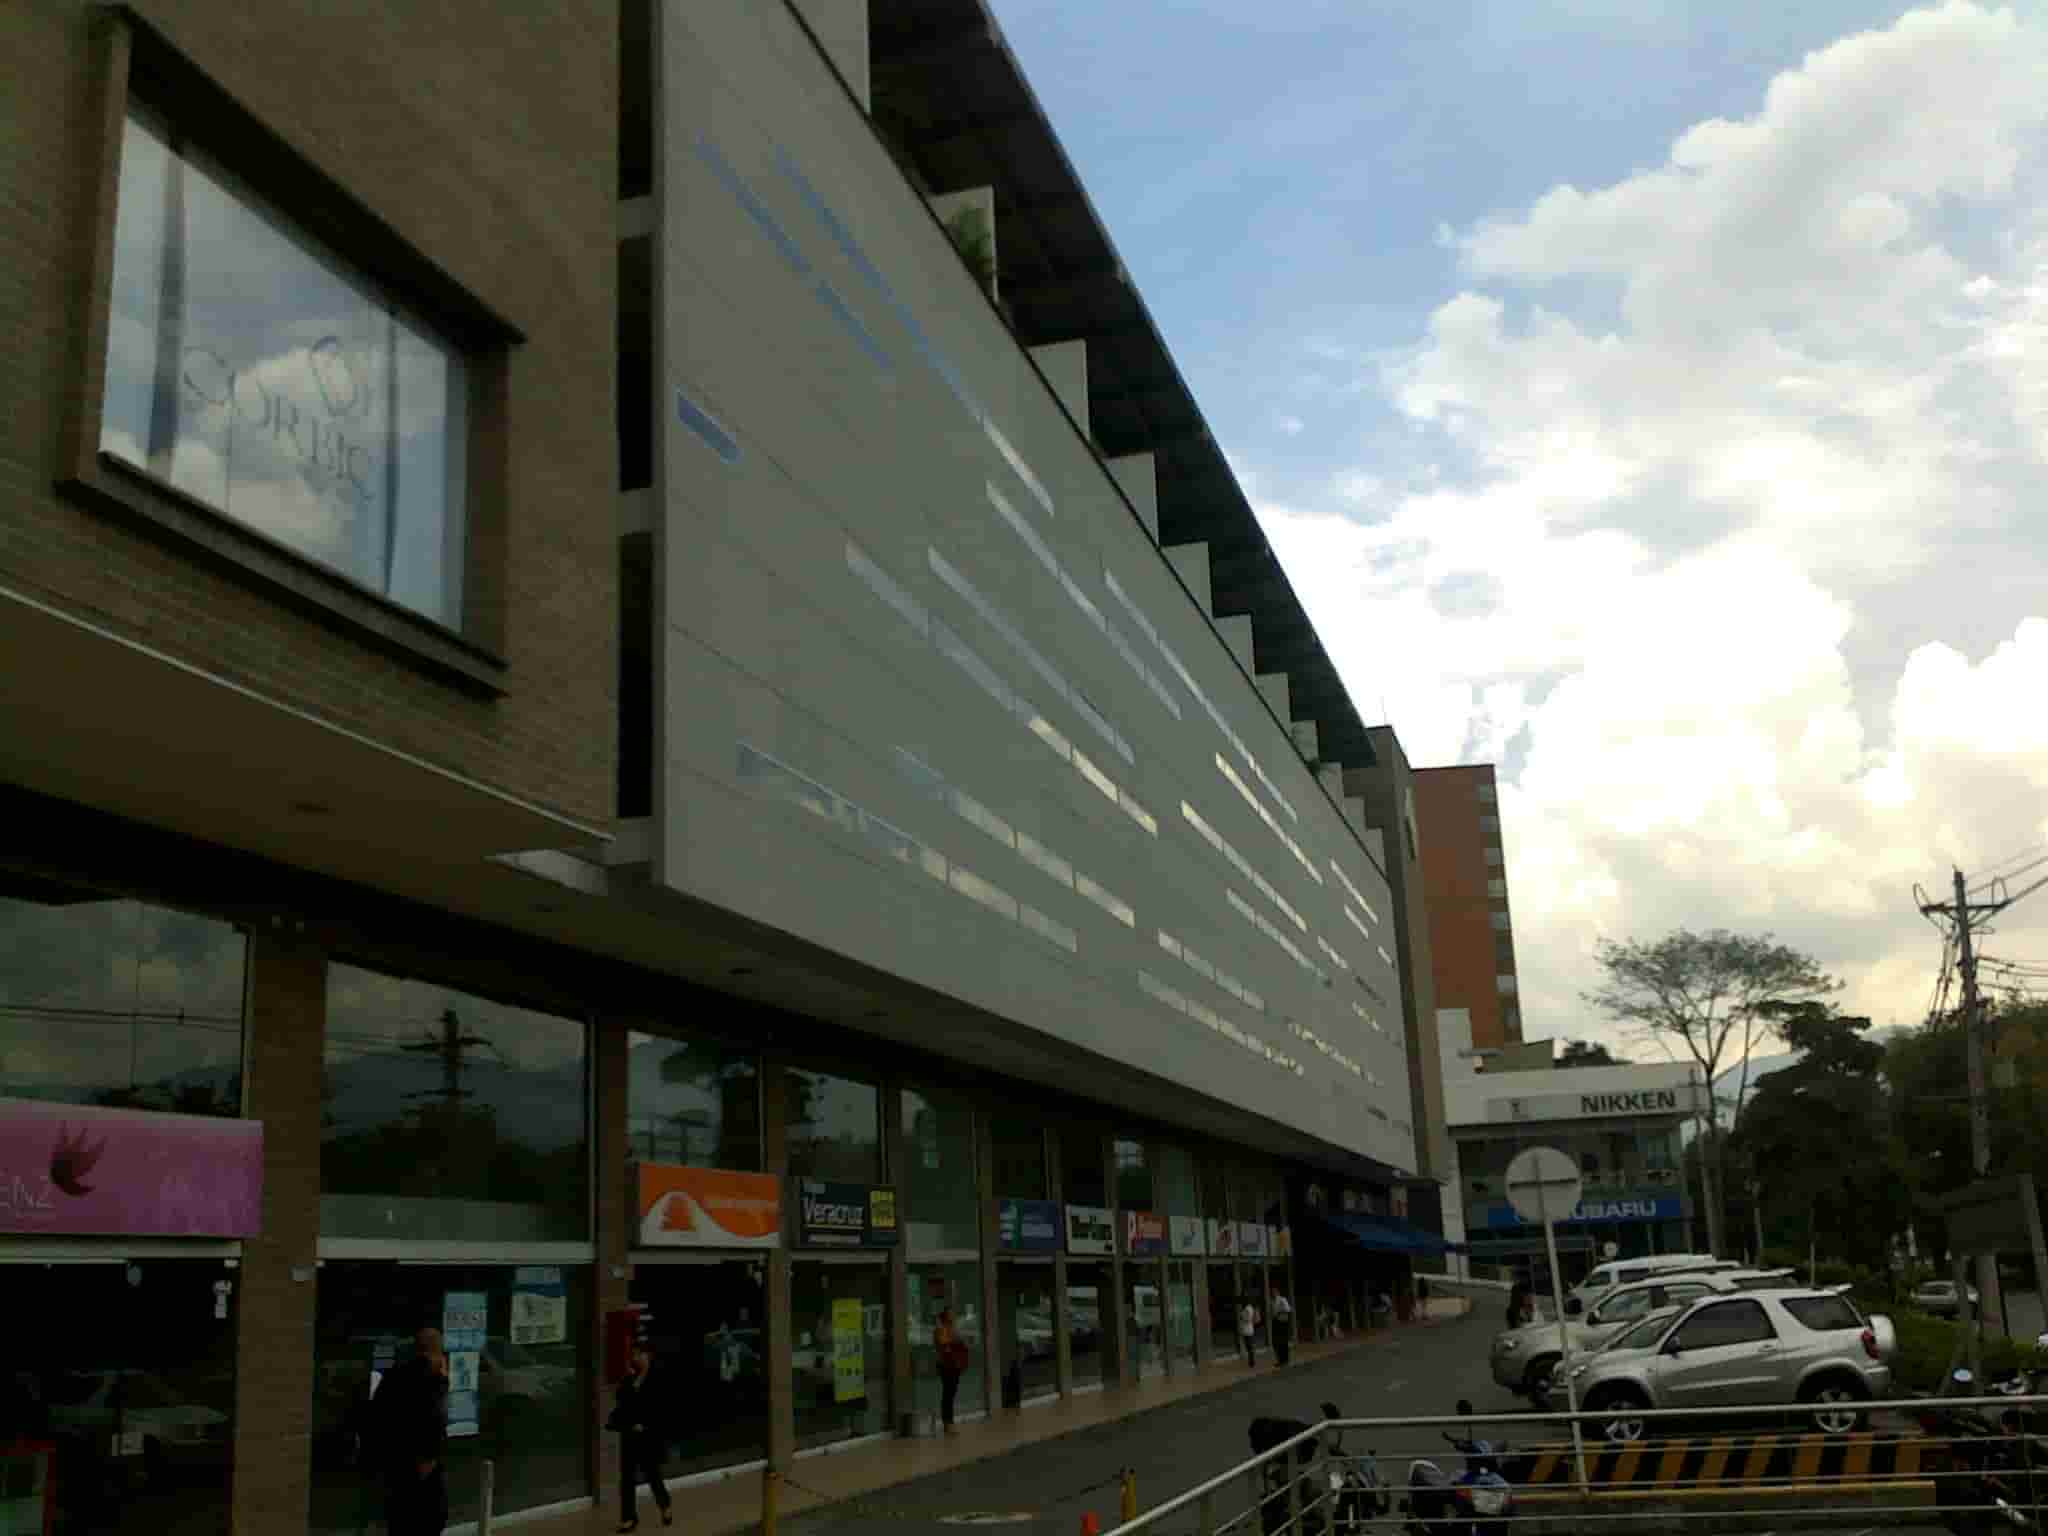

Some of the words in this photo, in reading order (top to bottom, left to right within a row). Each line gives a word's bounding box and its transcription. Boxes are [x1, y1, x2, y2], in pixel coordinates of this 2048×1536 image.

[1581, 1090, 1676, 1113] NIKKEN
[803, 1196, 865, 1224] Veracruz
[1571, 1200, 1657, 1219] UBARU
